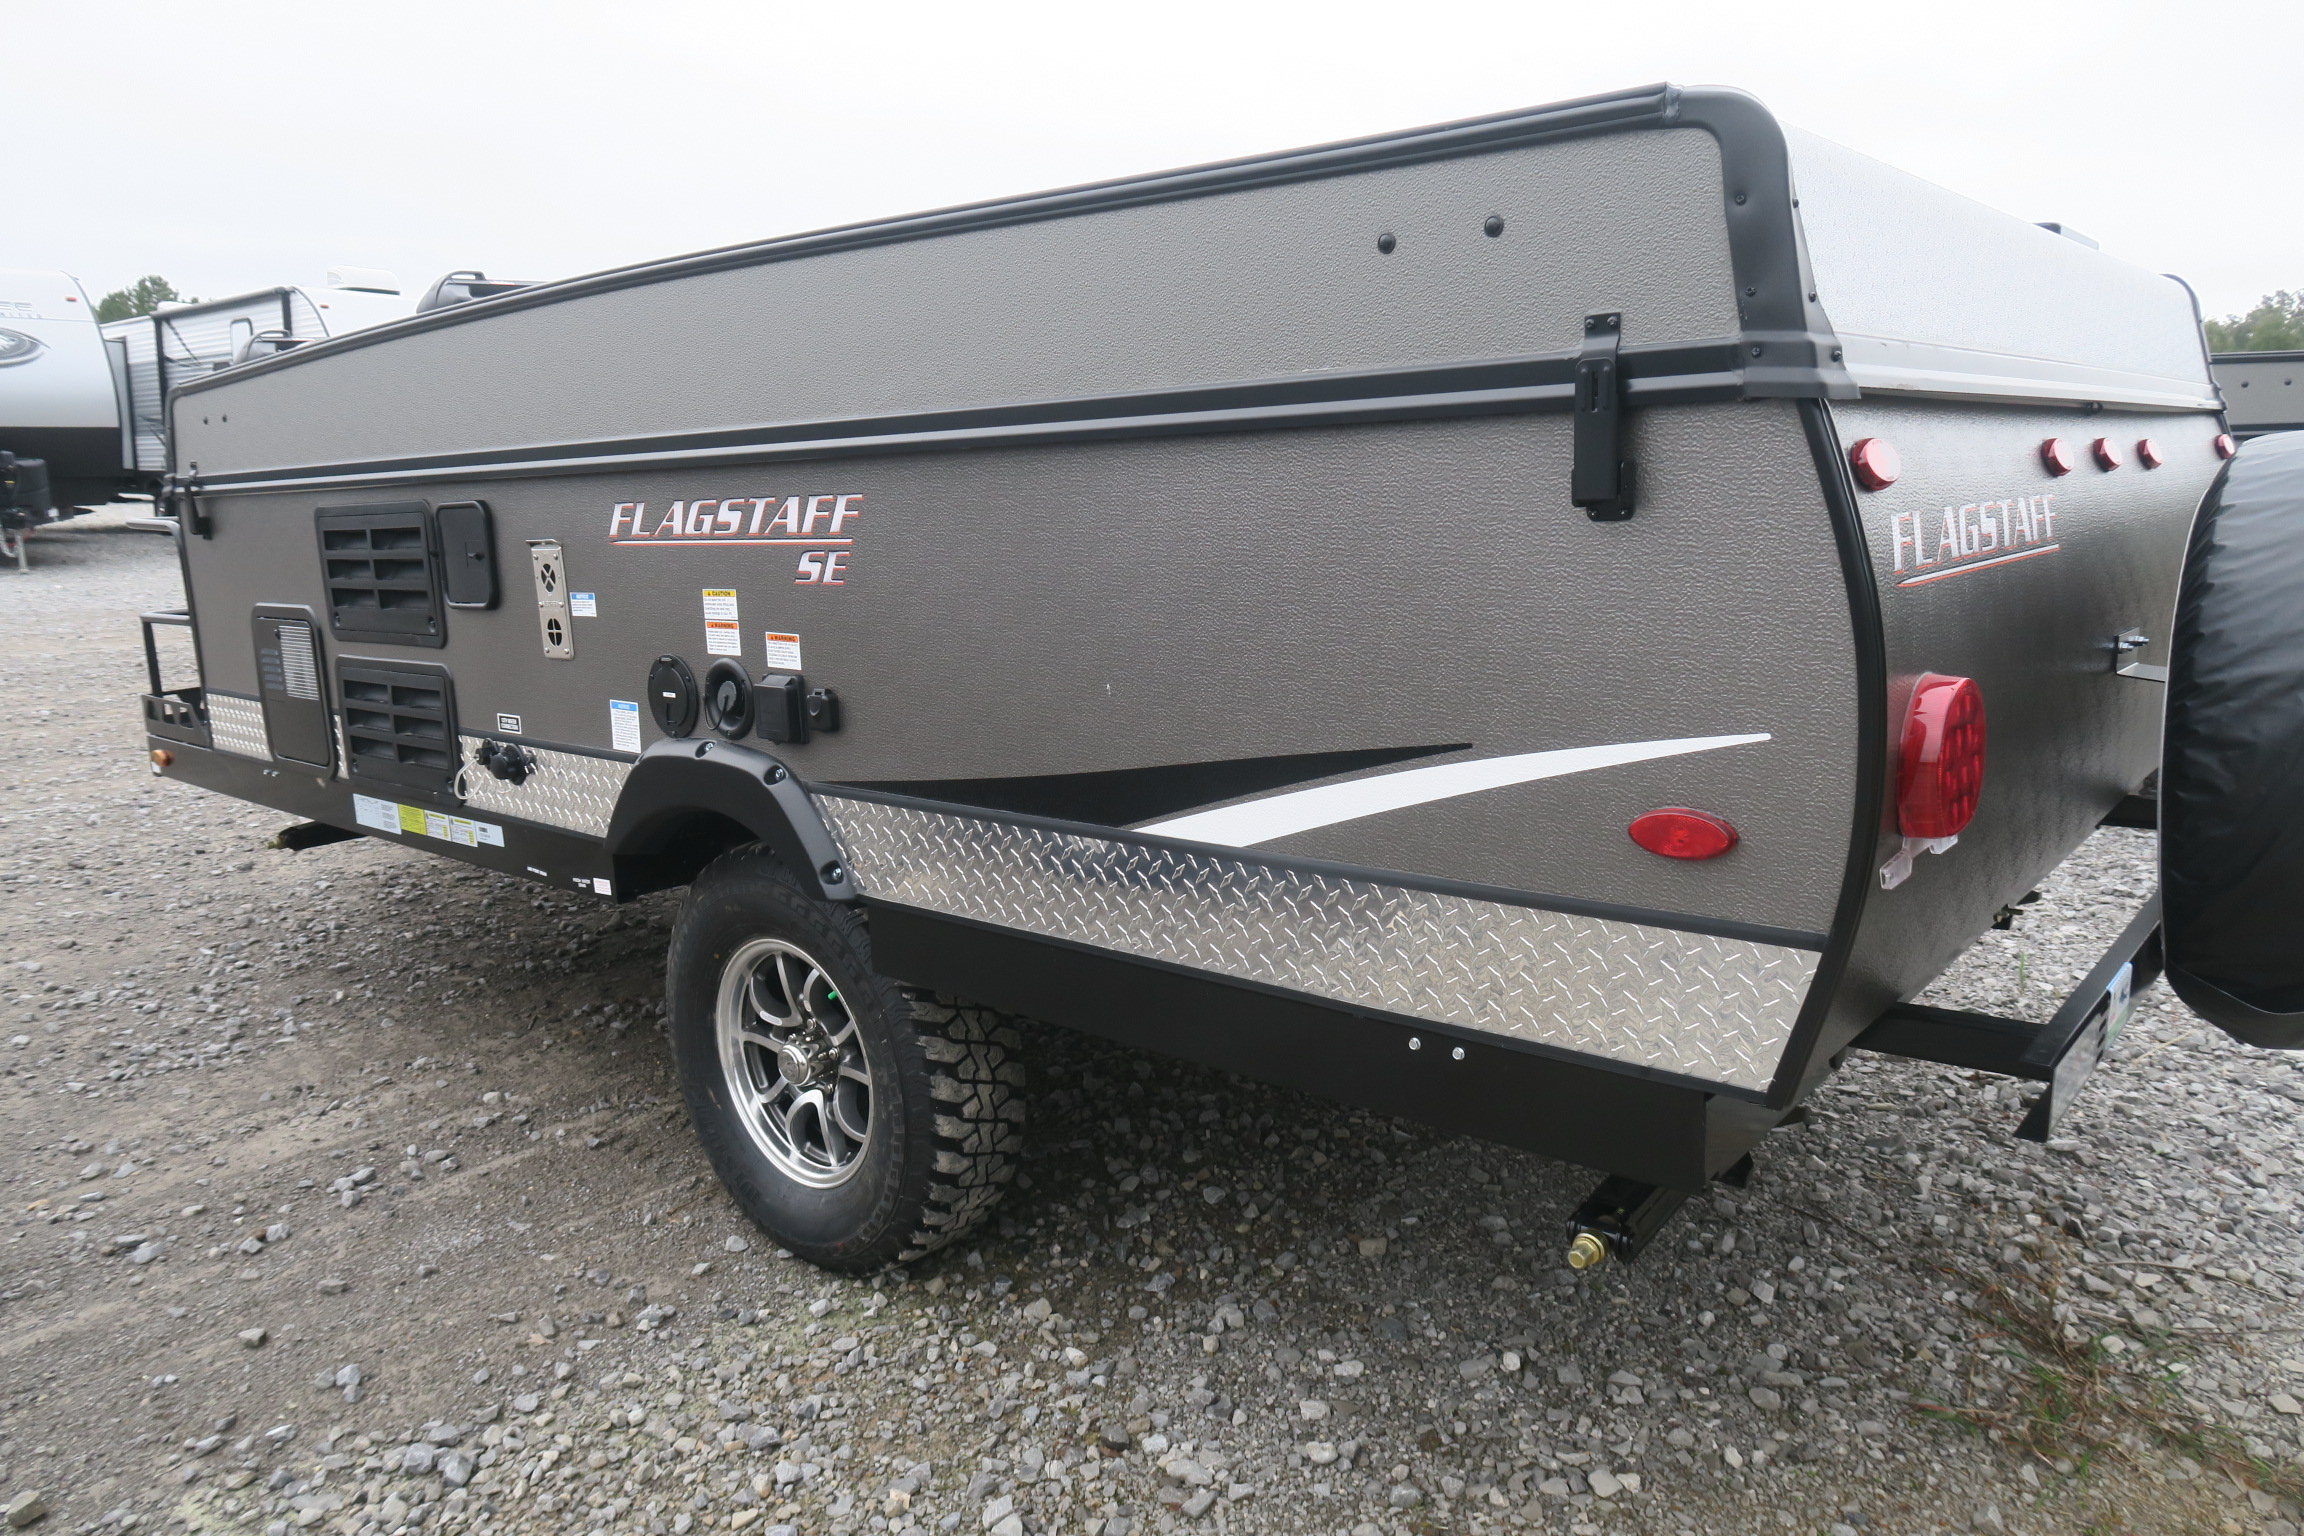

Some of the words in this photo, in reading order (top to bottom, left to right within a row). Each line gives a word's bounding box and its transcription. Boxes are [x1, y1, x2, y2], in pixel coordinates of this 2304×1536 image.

[608, 493, 863, 538] FLAGSTAFF
[1891, 494, 2058, 575] FLAGSTAFF
[793, 550, 852, 585] SE
